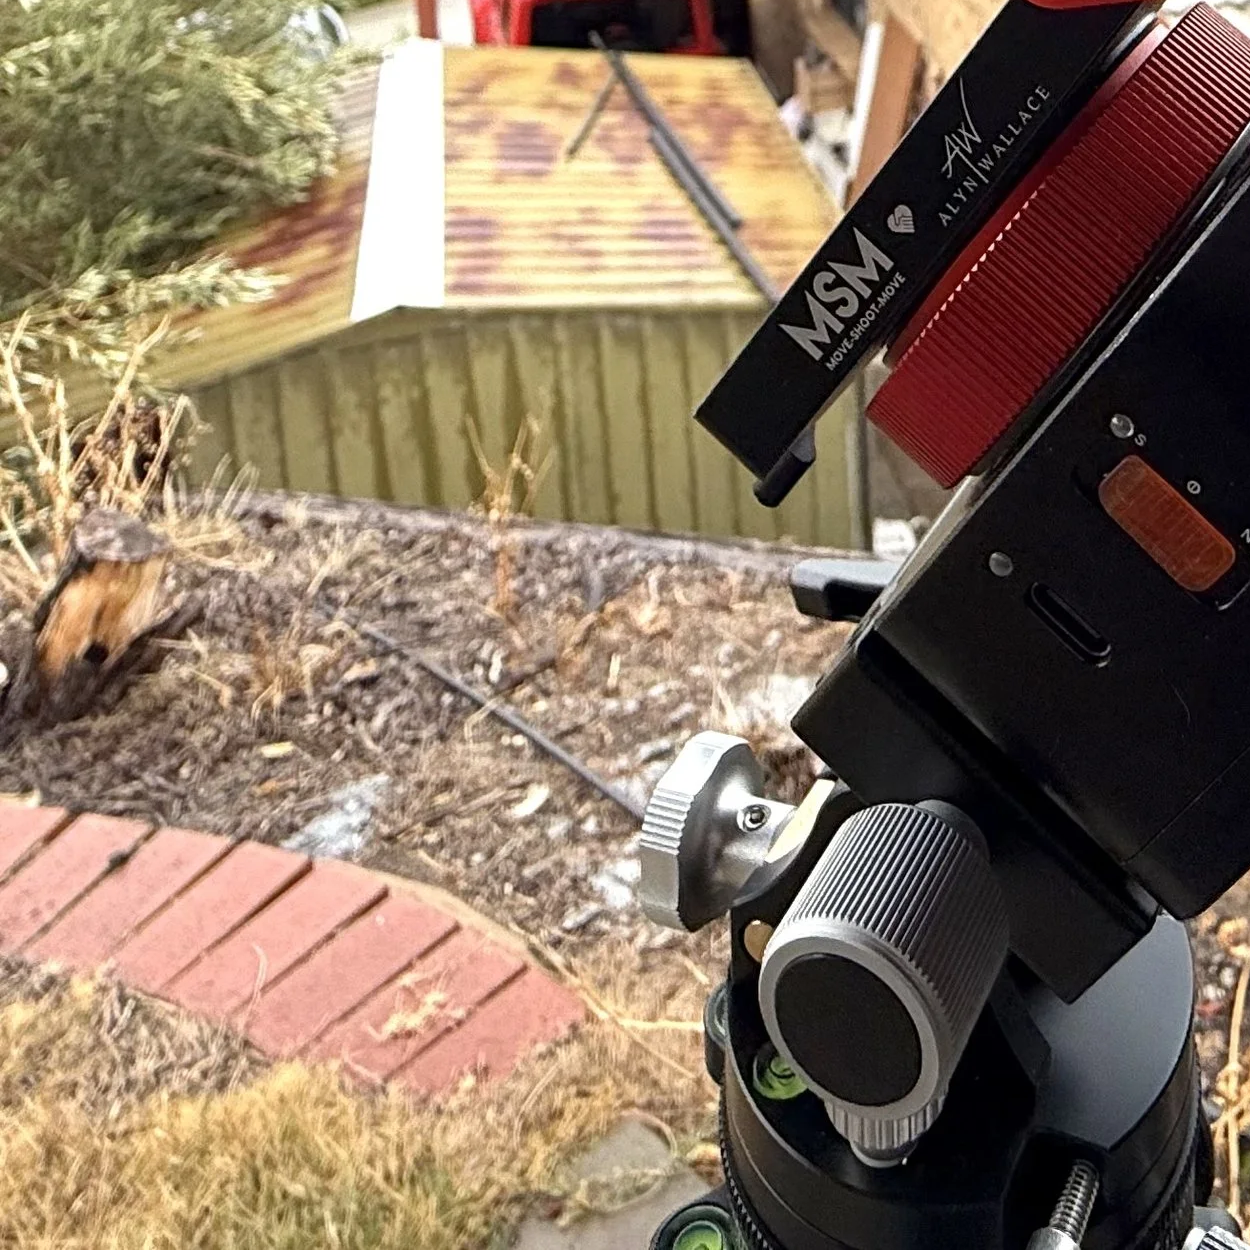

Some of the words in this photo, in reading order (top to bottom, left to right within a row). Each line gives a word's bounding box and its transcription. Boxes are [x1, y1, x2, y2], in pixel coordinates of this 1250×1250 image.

[938, 176, 978, 227] ALYN
[977, 85, 1051, 173] WALLACE
[778, 227, 895, 362] MSM
[825, 271, 906, 372] MOVE-SHOOT-MOVE
[1134, 433, 1147, 447] S
